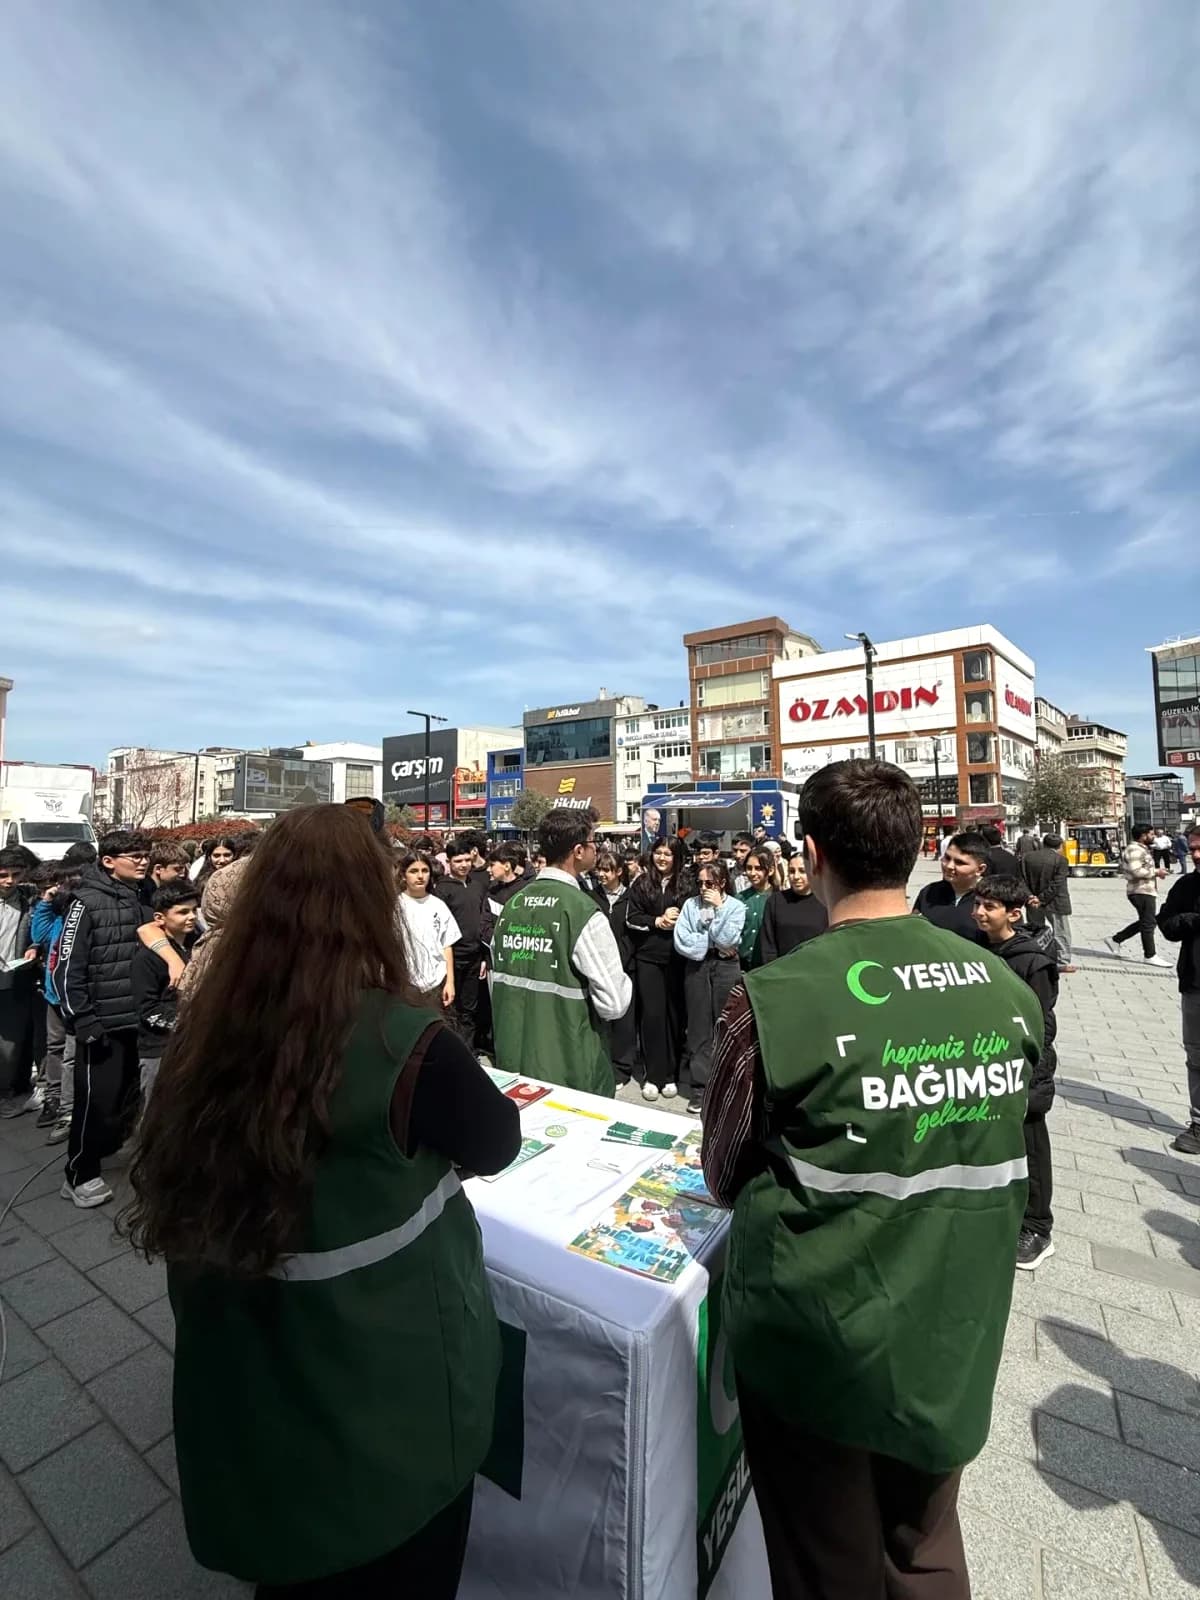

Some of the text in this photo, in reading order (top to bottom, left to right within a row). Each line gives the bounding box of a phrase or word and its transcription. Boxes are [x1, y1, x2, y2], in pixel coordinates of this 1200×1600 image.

[788, 683, 940, 722] ÖZAYDIN
[391, 757, 443, 781] çarşım
[524, 896, 559, 909] YEŞİLAY
[61, 929, 75, 960] Calvin
[503, 933, 553, 953] BAĞIMSIZ
[893, 961, 991, 992] YEŞİLAY
[882, 1030, 1009, 1072] hepimiz için
[861, 1058, 1025, 1110] BAĞIMSIZ
